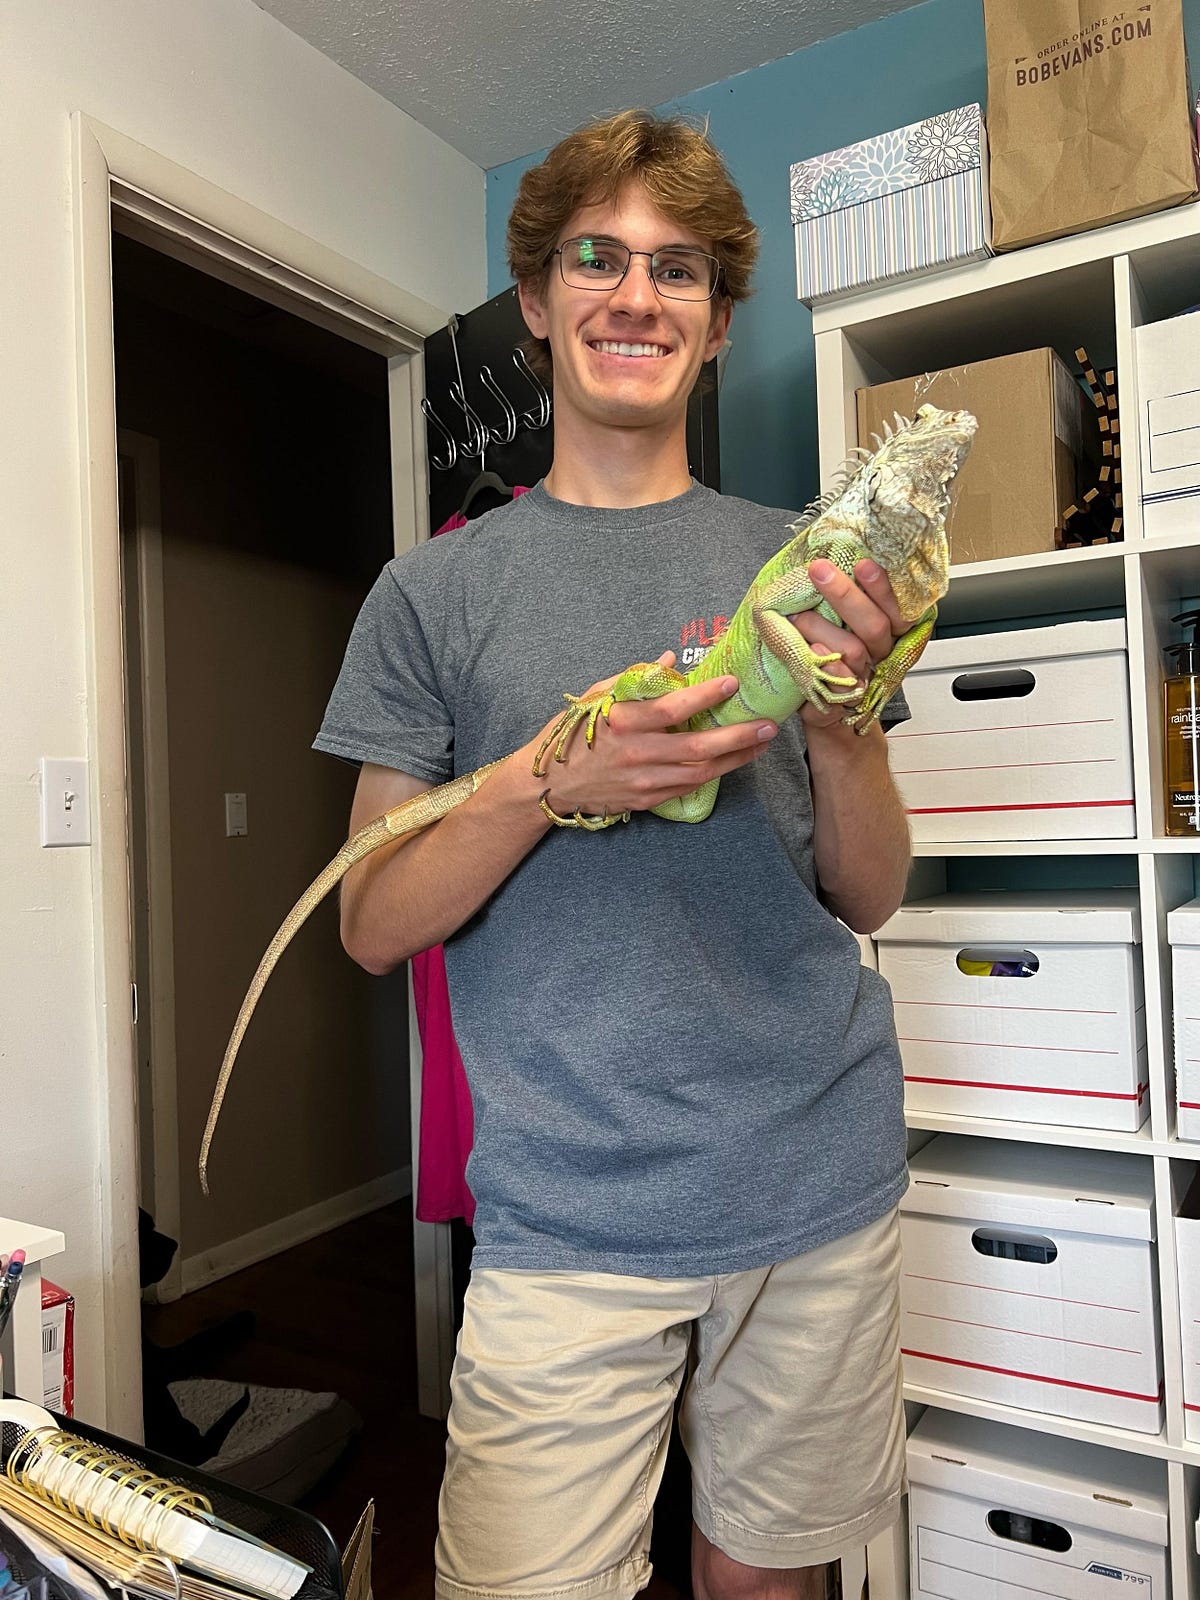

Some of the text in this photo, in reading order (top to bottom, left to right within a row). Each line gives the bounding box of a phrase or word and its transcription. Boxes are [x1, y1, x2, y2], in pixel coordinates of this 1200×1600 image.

[1016, 17, 1152, 87] BOBEVANS.COM
[1037, 12, 1126, 59] ORDER ONLINE AT
[682, 647, 709, 665] CR
